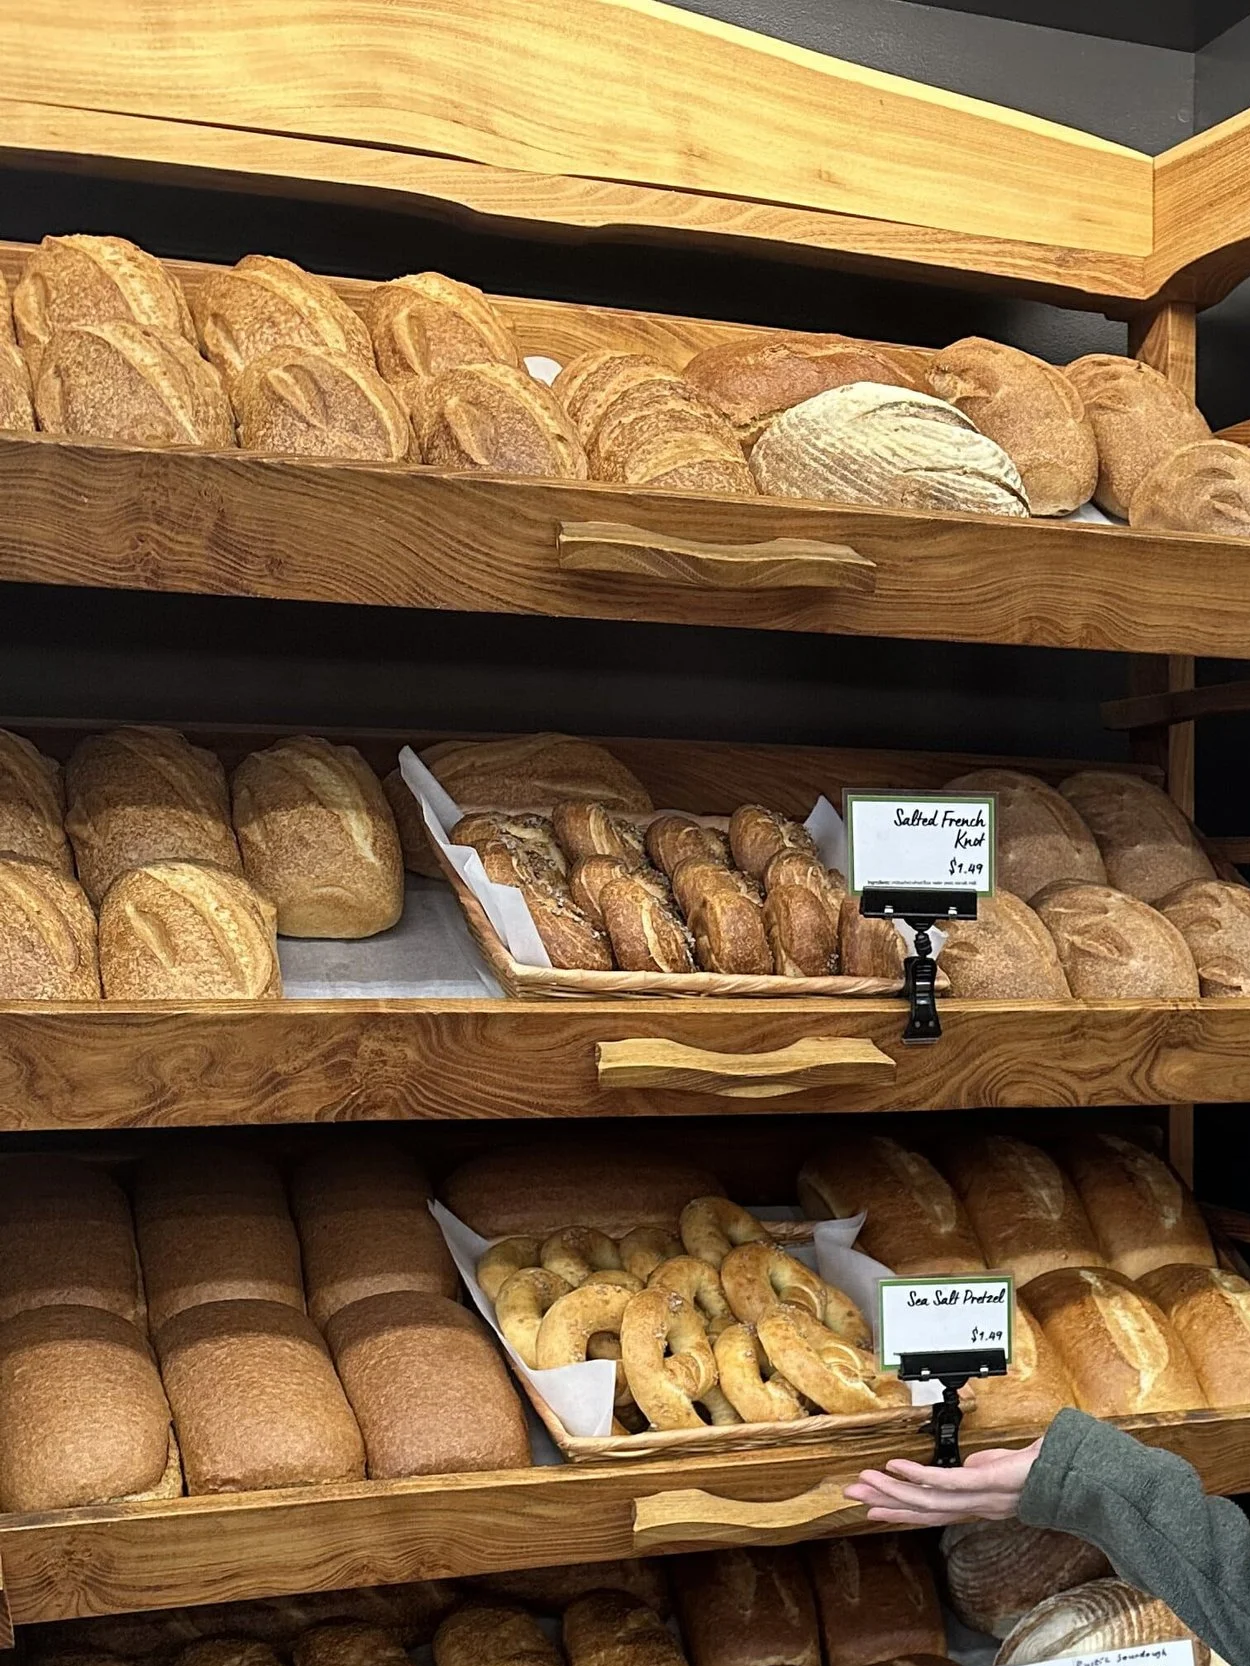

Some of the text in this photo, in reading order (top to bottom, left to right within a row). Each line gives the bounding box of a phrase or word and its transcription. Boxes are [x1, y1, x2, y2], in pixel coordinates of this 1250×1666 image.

[894, 808, 986, 828] Salted French
[954, 828, 986, 850] Knot
[949, 857, 983, 876] $1.49
[907, 1287, 1006, 1307] Sea Salt Pretzel
[971, 1326, 1003, 1343] $1.49
